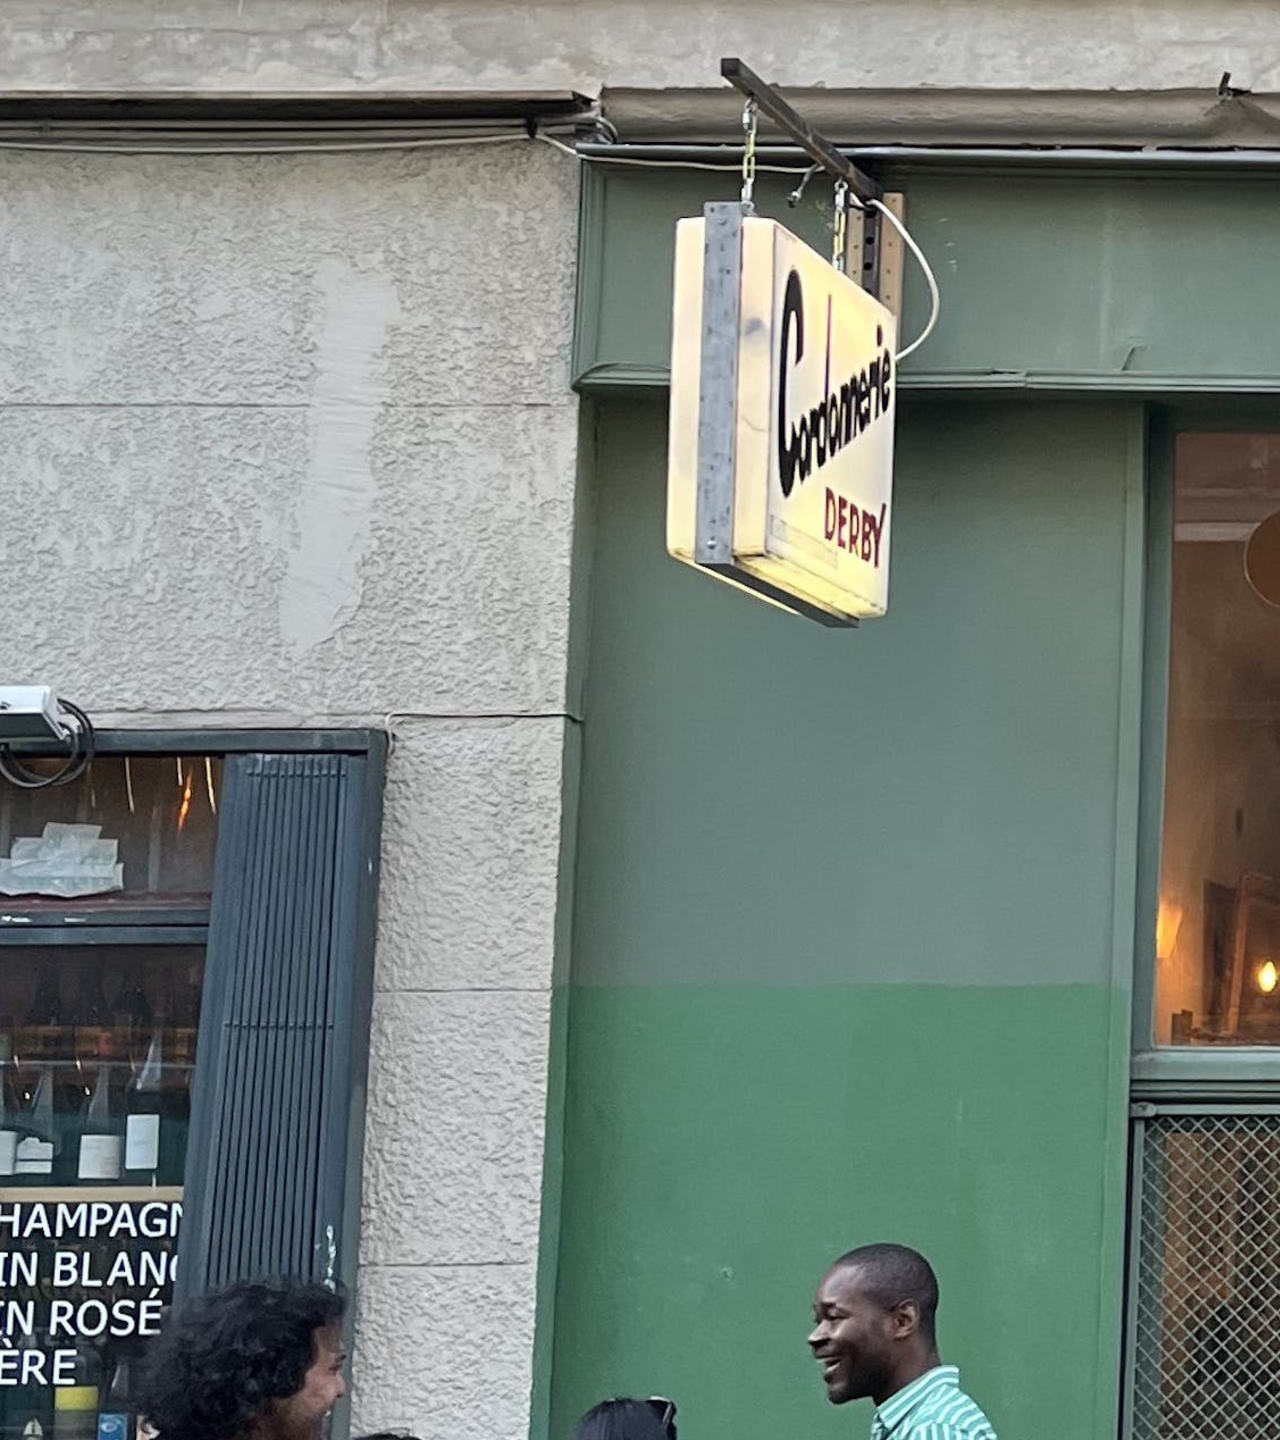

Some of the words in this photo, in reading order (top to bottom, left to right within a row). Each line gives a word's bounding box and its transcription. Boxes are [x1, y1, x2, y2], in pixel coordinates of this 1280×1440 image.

[777, 269, 891, 498] Cordonnerie
[824, 486, 887, 569] DERBY
[49, 1287, 163, 1337] ROSÉ
